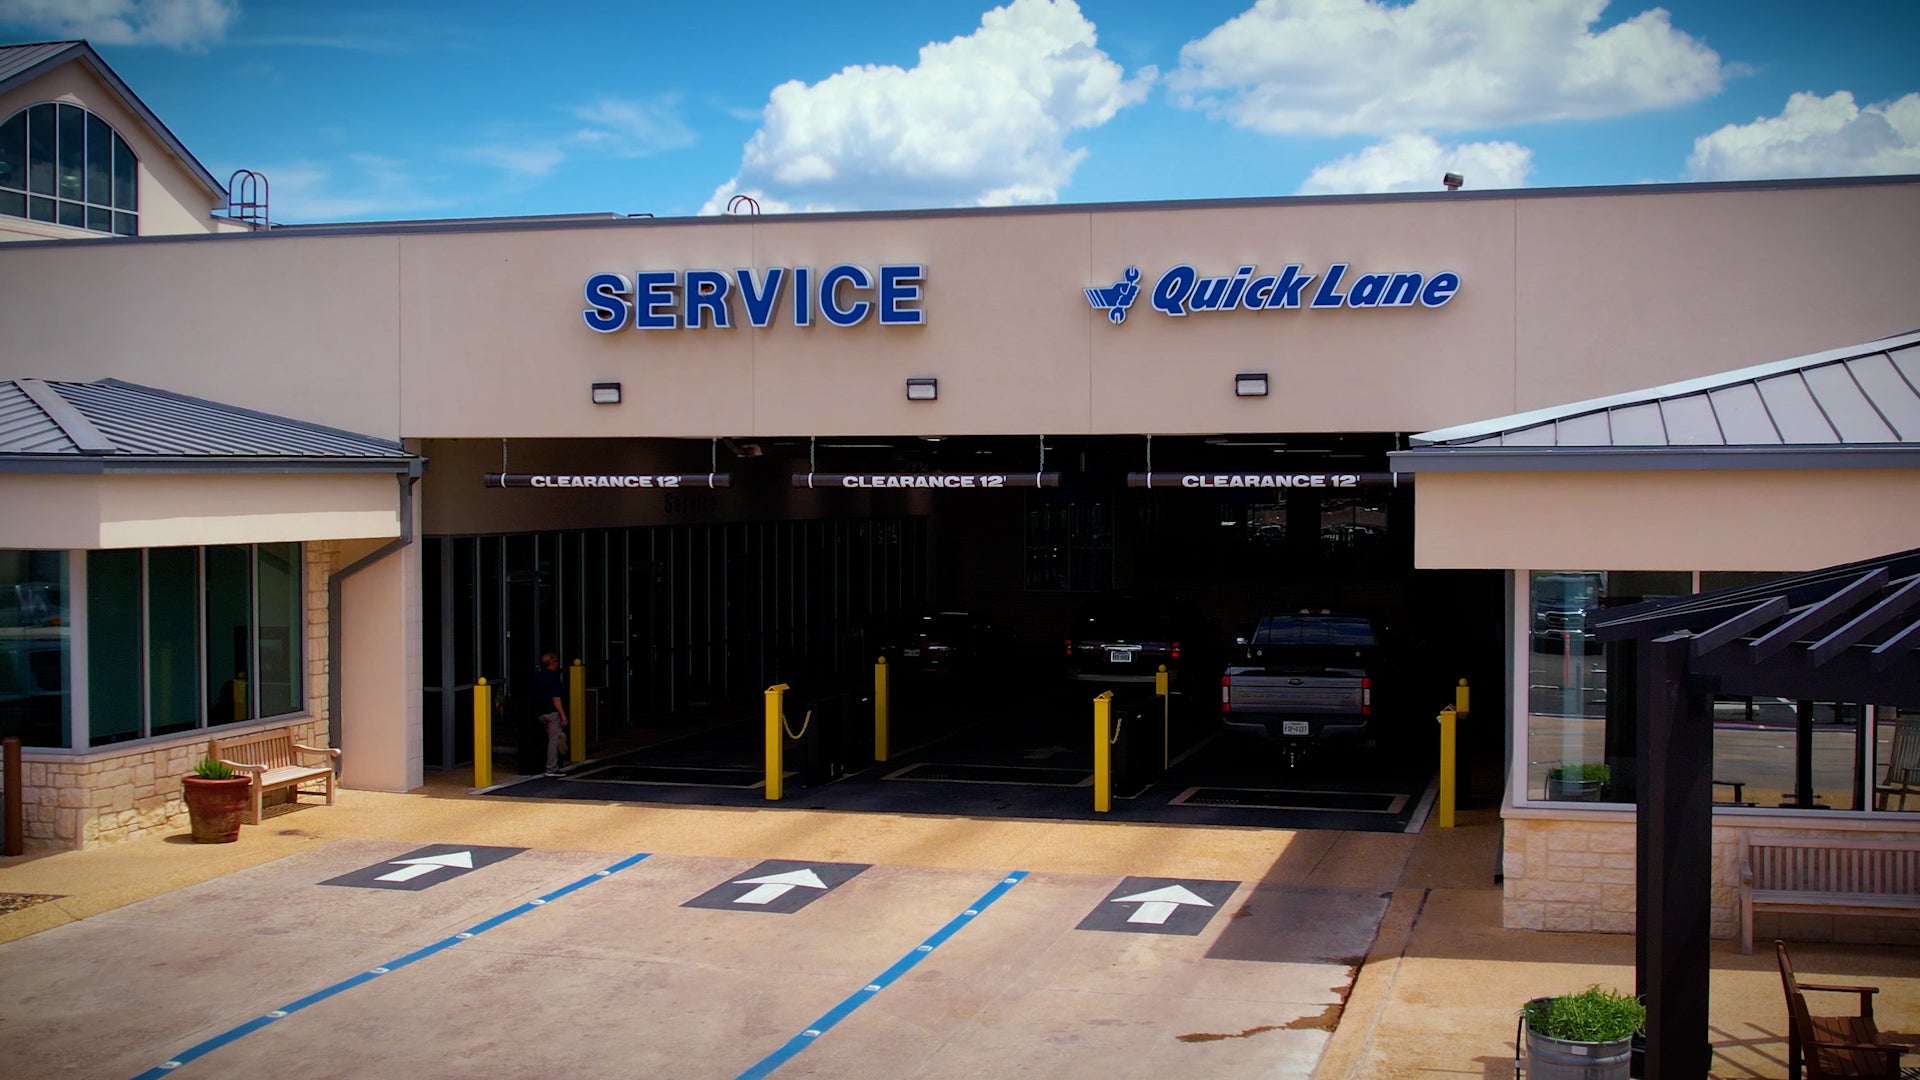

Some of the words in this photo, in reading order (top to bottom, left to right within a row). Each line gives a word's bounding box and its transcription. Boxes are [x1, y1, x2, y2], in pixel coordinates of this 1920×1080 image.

[1152, 264, 1318, 316] Quick
[1310, 263, 1461, 309] Lane
[583, 264, 927, 333] SERVICE
[530, 475, 653, 488] CLEARANCE
[656, 475, 682, 488] 12'
[842, 475, 975, 488] CLEARANCE
[979, 475, 1007, 488] 12'
[1181, 475, 1326, 488] CLEARANCE
[1331, 475, 1360, 488] 12'
